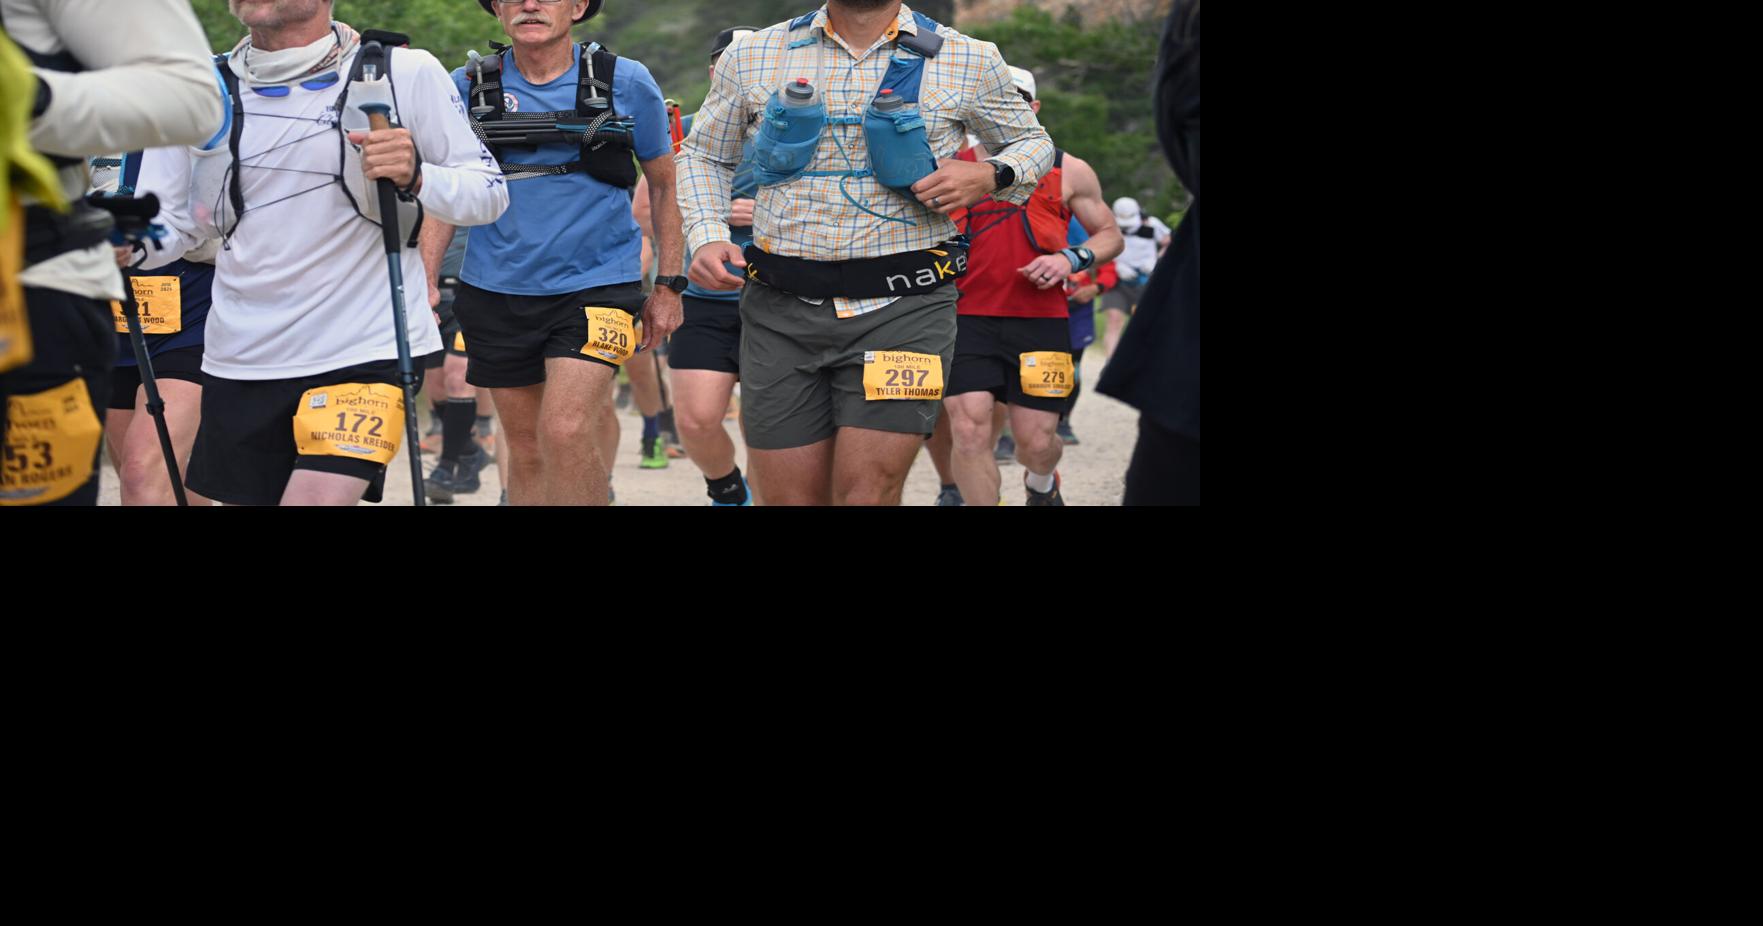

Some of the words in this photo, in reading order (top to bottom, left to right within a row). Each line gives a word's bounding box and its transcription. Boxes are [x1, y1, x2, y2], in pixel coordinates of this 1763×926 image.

[886, 252, 967, 291] nake
[598, 327, 628, 348] 320
[592, 340, 612, 351] BLAKE
[883, 353, 931, 364] bighorn
[885, 368, 930, 387] 297
[1042, 371, 1065, 384] 279
[876, 387, 900, 396] TYLER
[904, 388, 940, 397] THOMAS
[336, 396, 389, 409] bighorn
[335, 411, 384, 437] 172
[311, 431, 360, 445] NICHOLAS
[4, 441, 52, 472] 53
